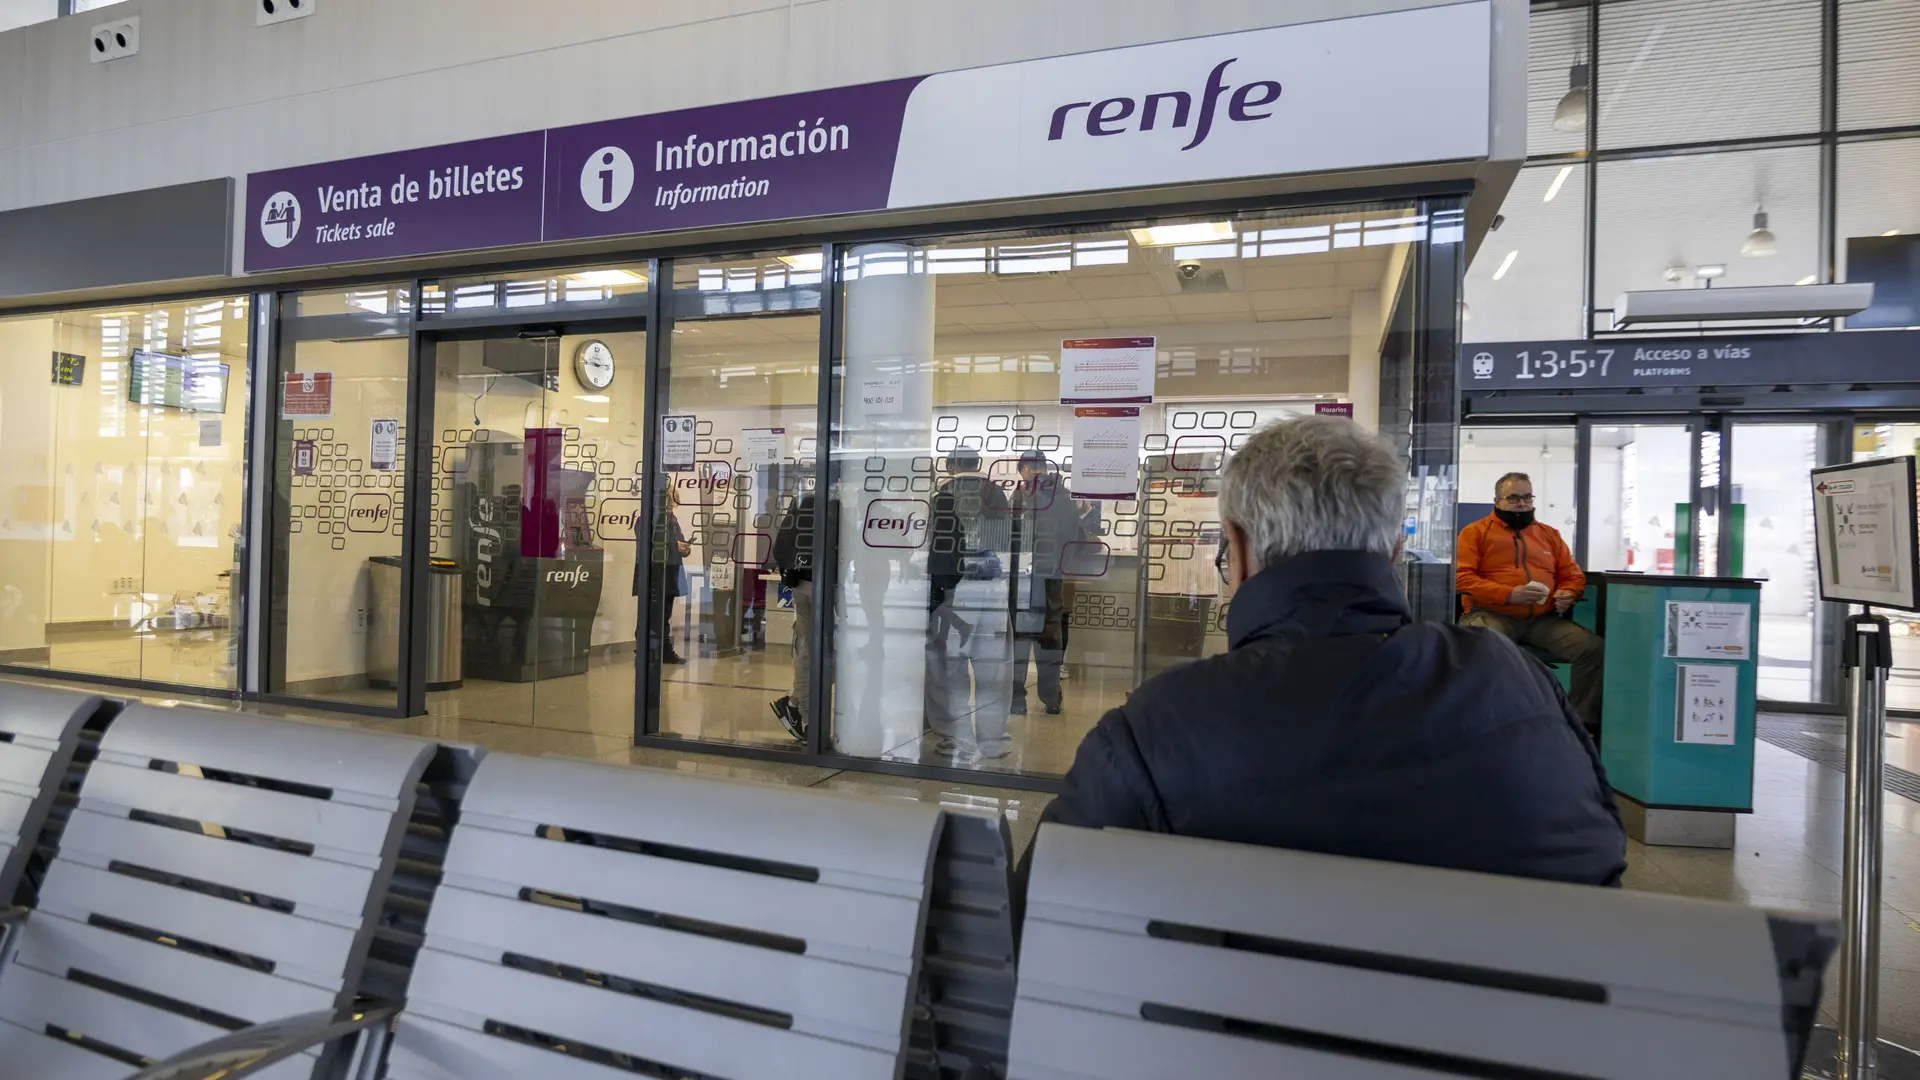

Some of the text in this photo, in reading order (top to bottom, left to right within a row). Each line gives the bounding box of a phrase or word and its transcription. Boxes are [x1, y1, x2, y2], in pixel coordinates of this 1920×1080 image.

[1048, 57, 1282, 151] renfe
[656, 117, 849, 173] Información
[318, 164, 524, 213] Venta de billetes
[655, 176, 769, 211] Information
[316, 218, 396, 244] Tickets sale
[1633, 343, 1751, 361] Acceso a vías
[1633, 367, 1691, 377] PLATFORMS
[1320, 406, 1348, 414] Horarios
[678, 472, 728, 495] renfe
[991, 473, 1054, 497] renfe
[350, 503, 389, 524] renfe
[867, 511, 927, 537] renfe
[469, 497, 503, 607] renfe
[546, 564, 590, 589] renfe
